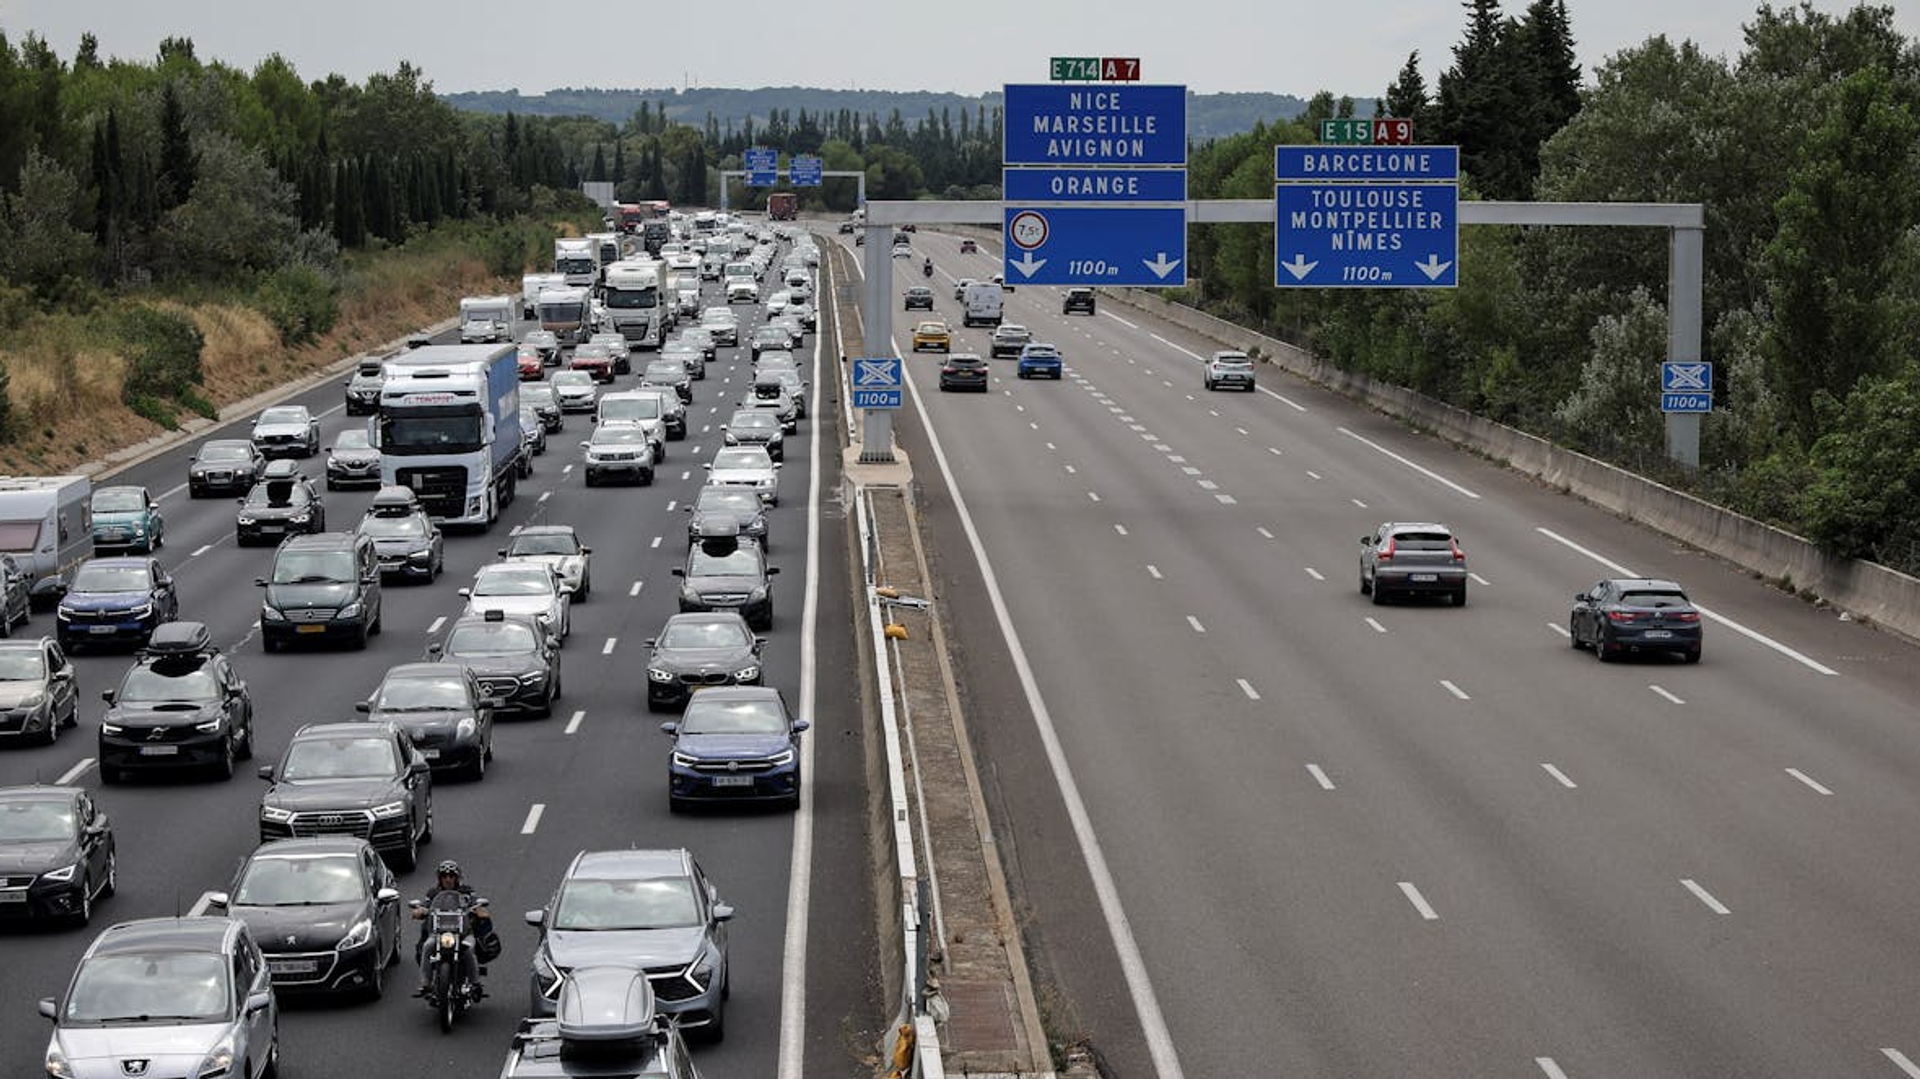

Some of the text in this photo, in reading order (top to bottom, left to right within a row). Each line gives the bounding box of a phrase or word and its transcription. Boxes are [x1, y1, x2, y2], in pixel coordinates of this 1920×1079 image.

[1070, 93, 1120, 109] NICE
[1034, 116, 1156, 133] MARSEILLE
[1047, 139, 1144, 157] AVIGNON
[1303, 155, 1431, 172] BARCELONE
[1052, 177, 1138, 194] ORANGE
[1312, 190, 1423, 208] TOULOUSE
[1291, 212, 1442, 229] MONTPELLIER
[1332, 230, 1402, 250] NÎMES
